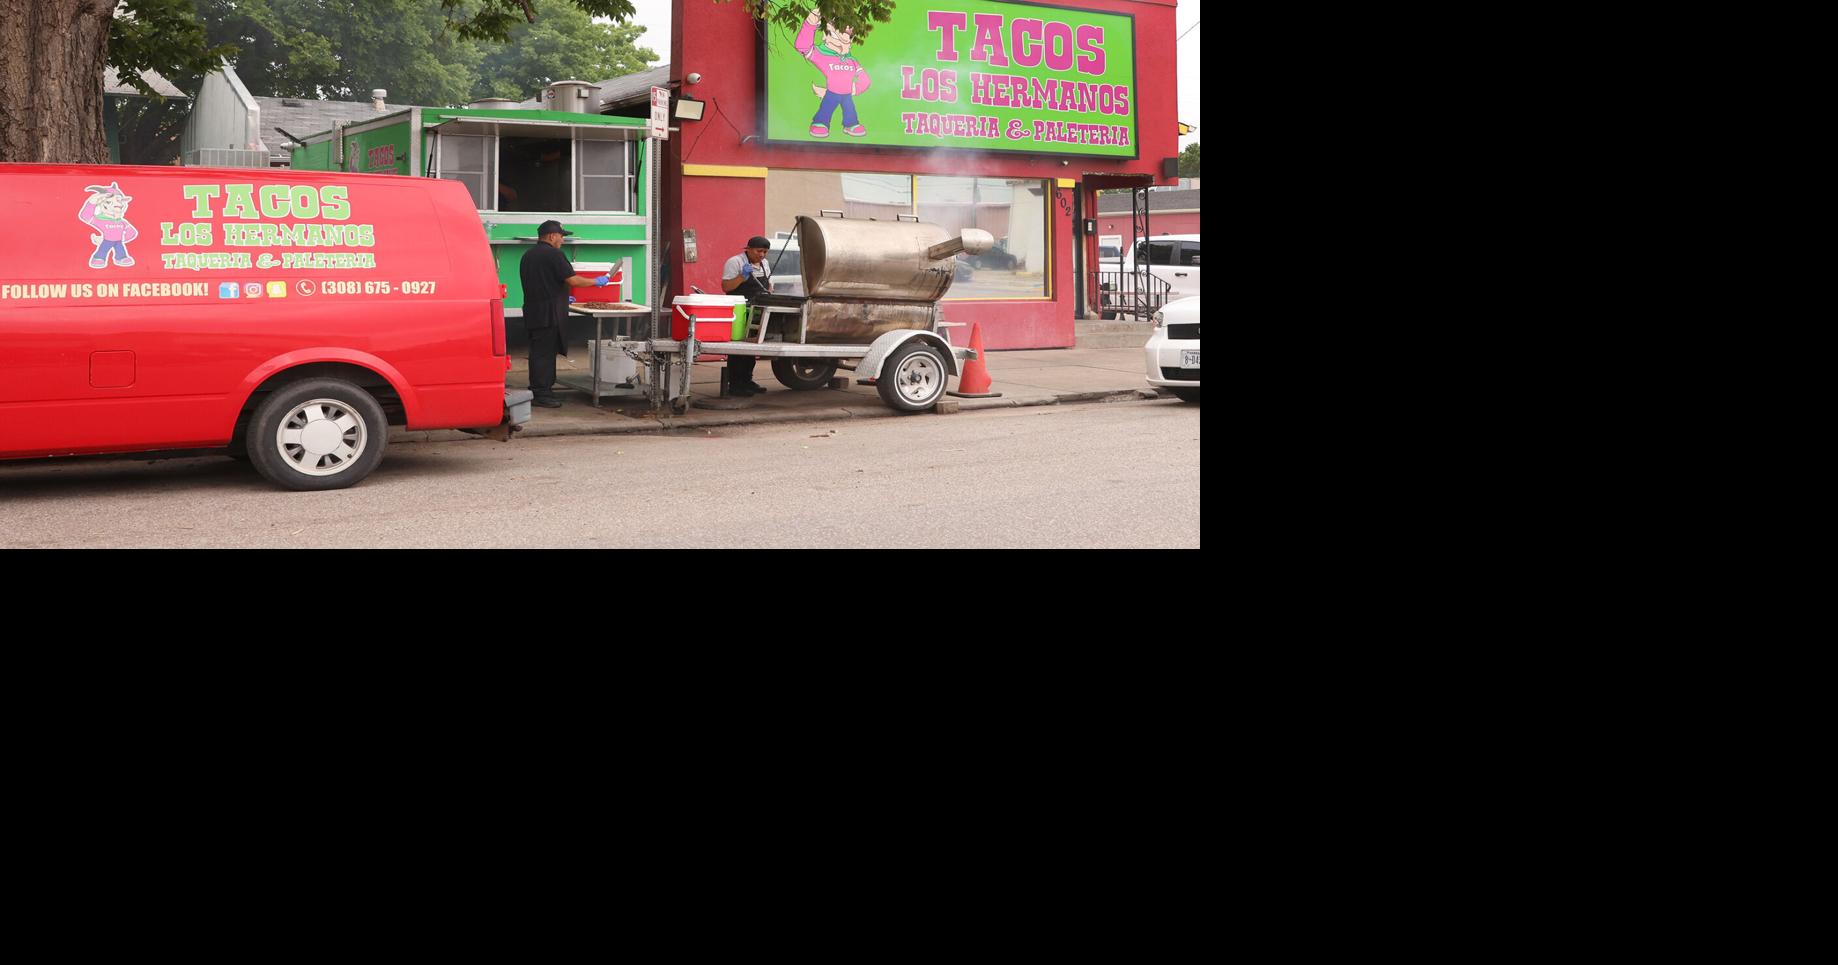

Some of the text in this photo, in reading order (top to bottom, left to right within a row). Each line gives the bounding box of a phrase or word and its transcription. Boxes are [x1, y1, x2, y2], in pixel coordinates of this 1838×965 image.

[927, 11, 1107, 76] TACOS
[828, 63, 855, 72] Tacos
[901, 66, 1130, 116] LOS HERMANOS
[901, 112, 1130, 146] TAQUERIA & PALETERIA
[367, 144, 395, 169] TACOS
[183, 184, 351, 220] TACOS
[160, 222, 375, 247] LOS HERMANOS
[161, 252, 376, 271] TAQUERIA & PALETERIA
[2, 282, 209, 299] FOLLOW US ON FACEBOOK!
[321, 281, 361, 295] (308)
[365, 281, 391, 295] 675
[402, 281, 436, 295] 0927
